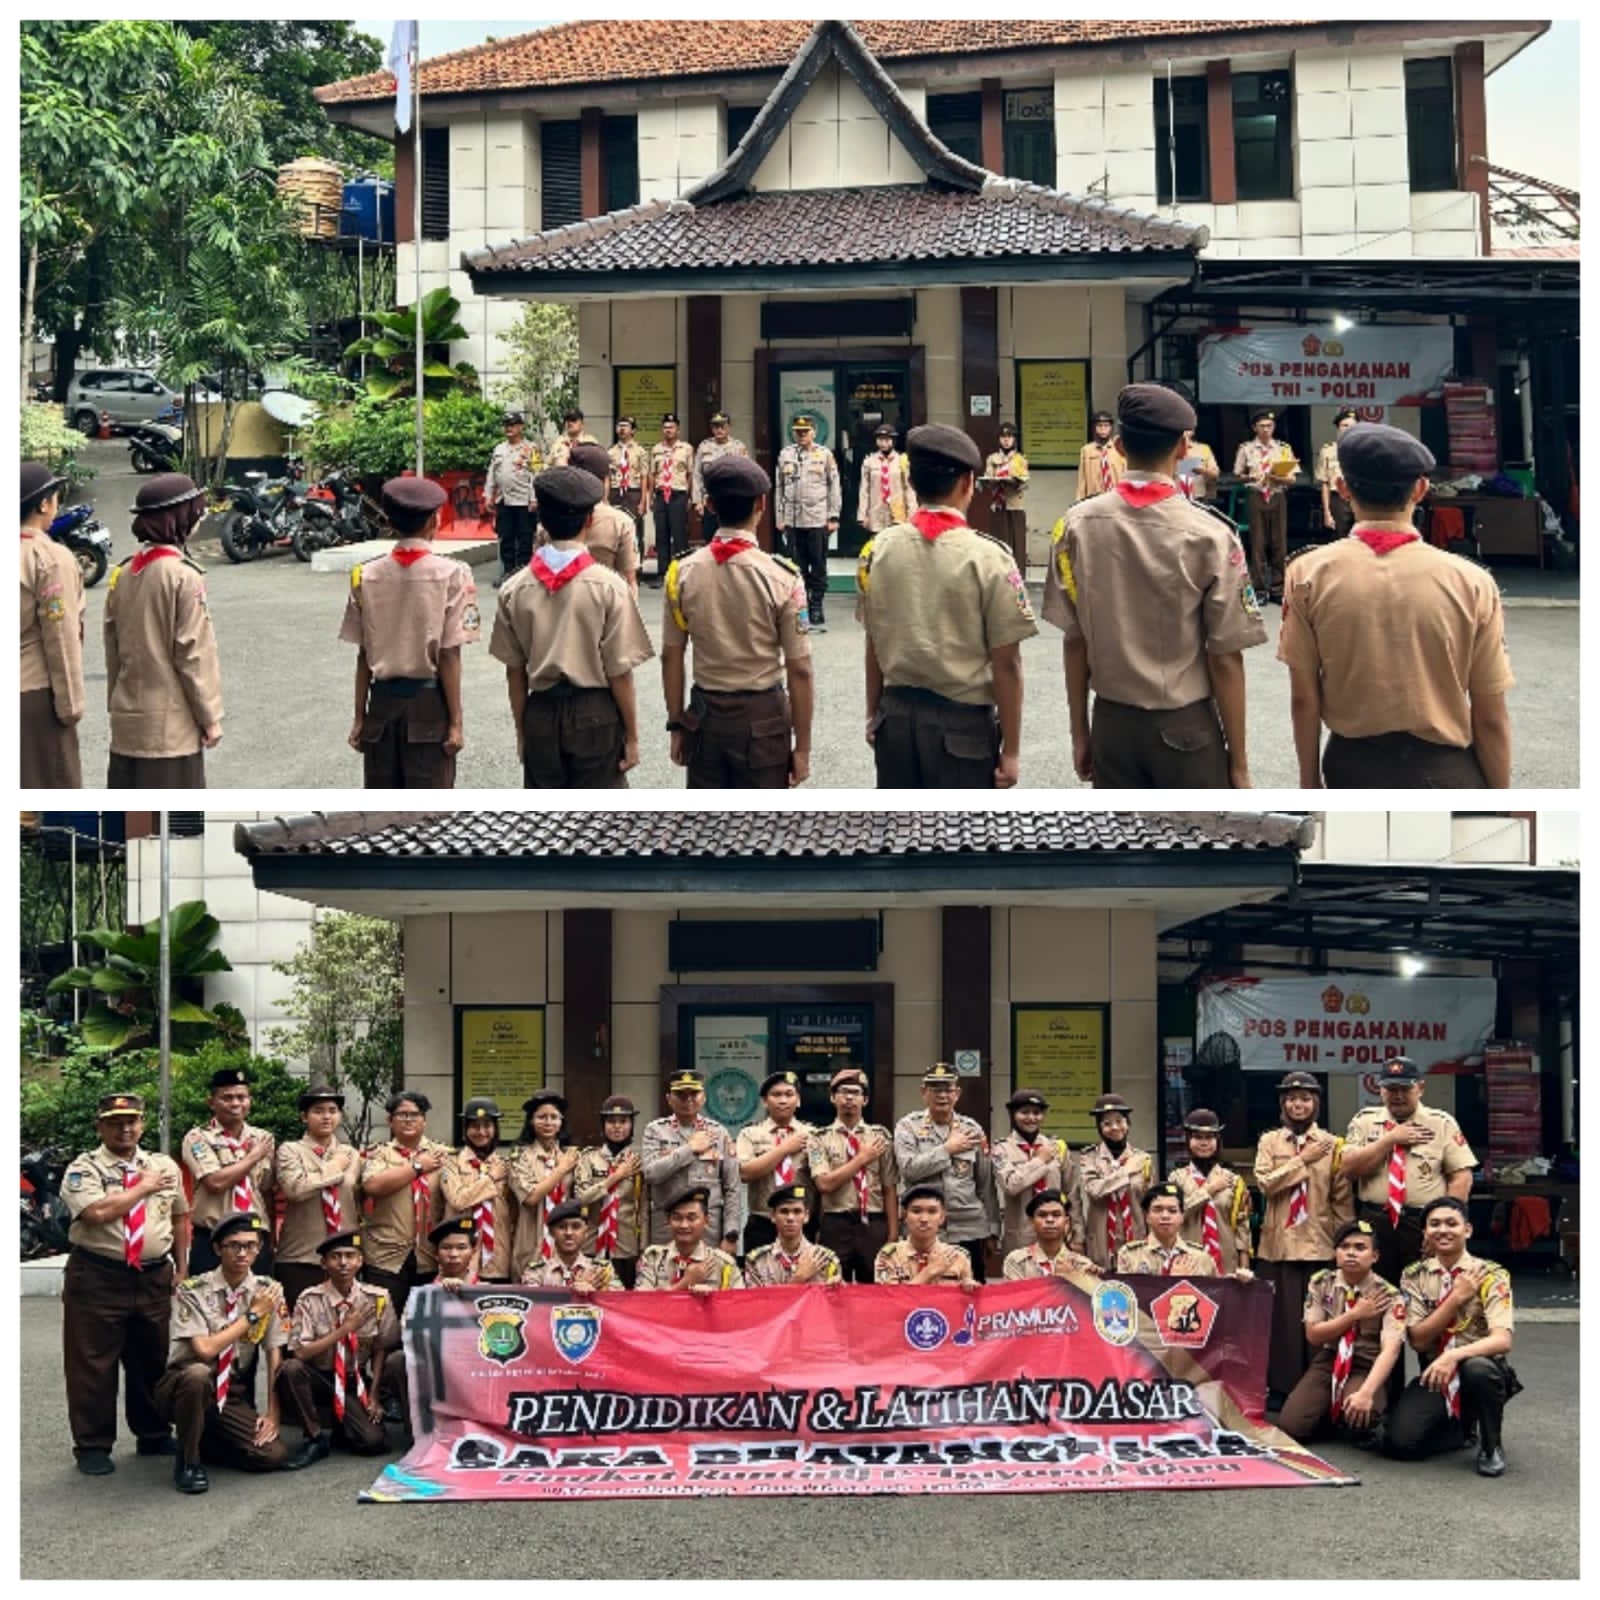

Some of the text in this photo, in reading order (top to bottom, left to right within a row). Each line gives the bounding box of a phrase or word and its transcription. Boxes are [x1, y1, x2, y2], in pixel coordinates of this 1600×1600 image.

[1238, 362, 1410, 378] POS PENGAMANAN
[1272, 382, 1300, 397] TNI
[1321, 382, 1376, 398] POLRI
[1244, 1019, 1447, 1041] POS PENGAMANAN
[1283, 1043, 1318, 1062] TNI
[976, 1304, 1079, 1332] PRAMUKA
[511, 1381, 1202, 1434] PENDIDIKAN & LATIHAN DASAR
